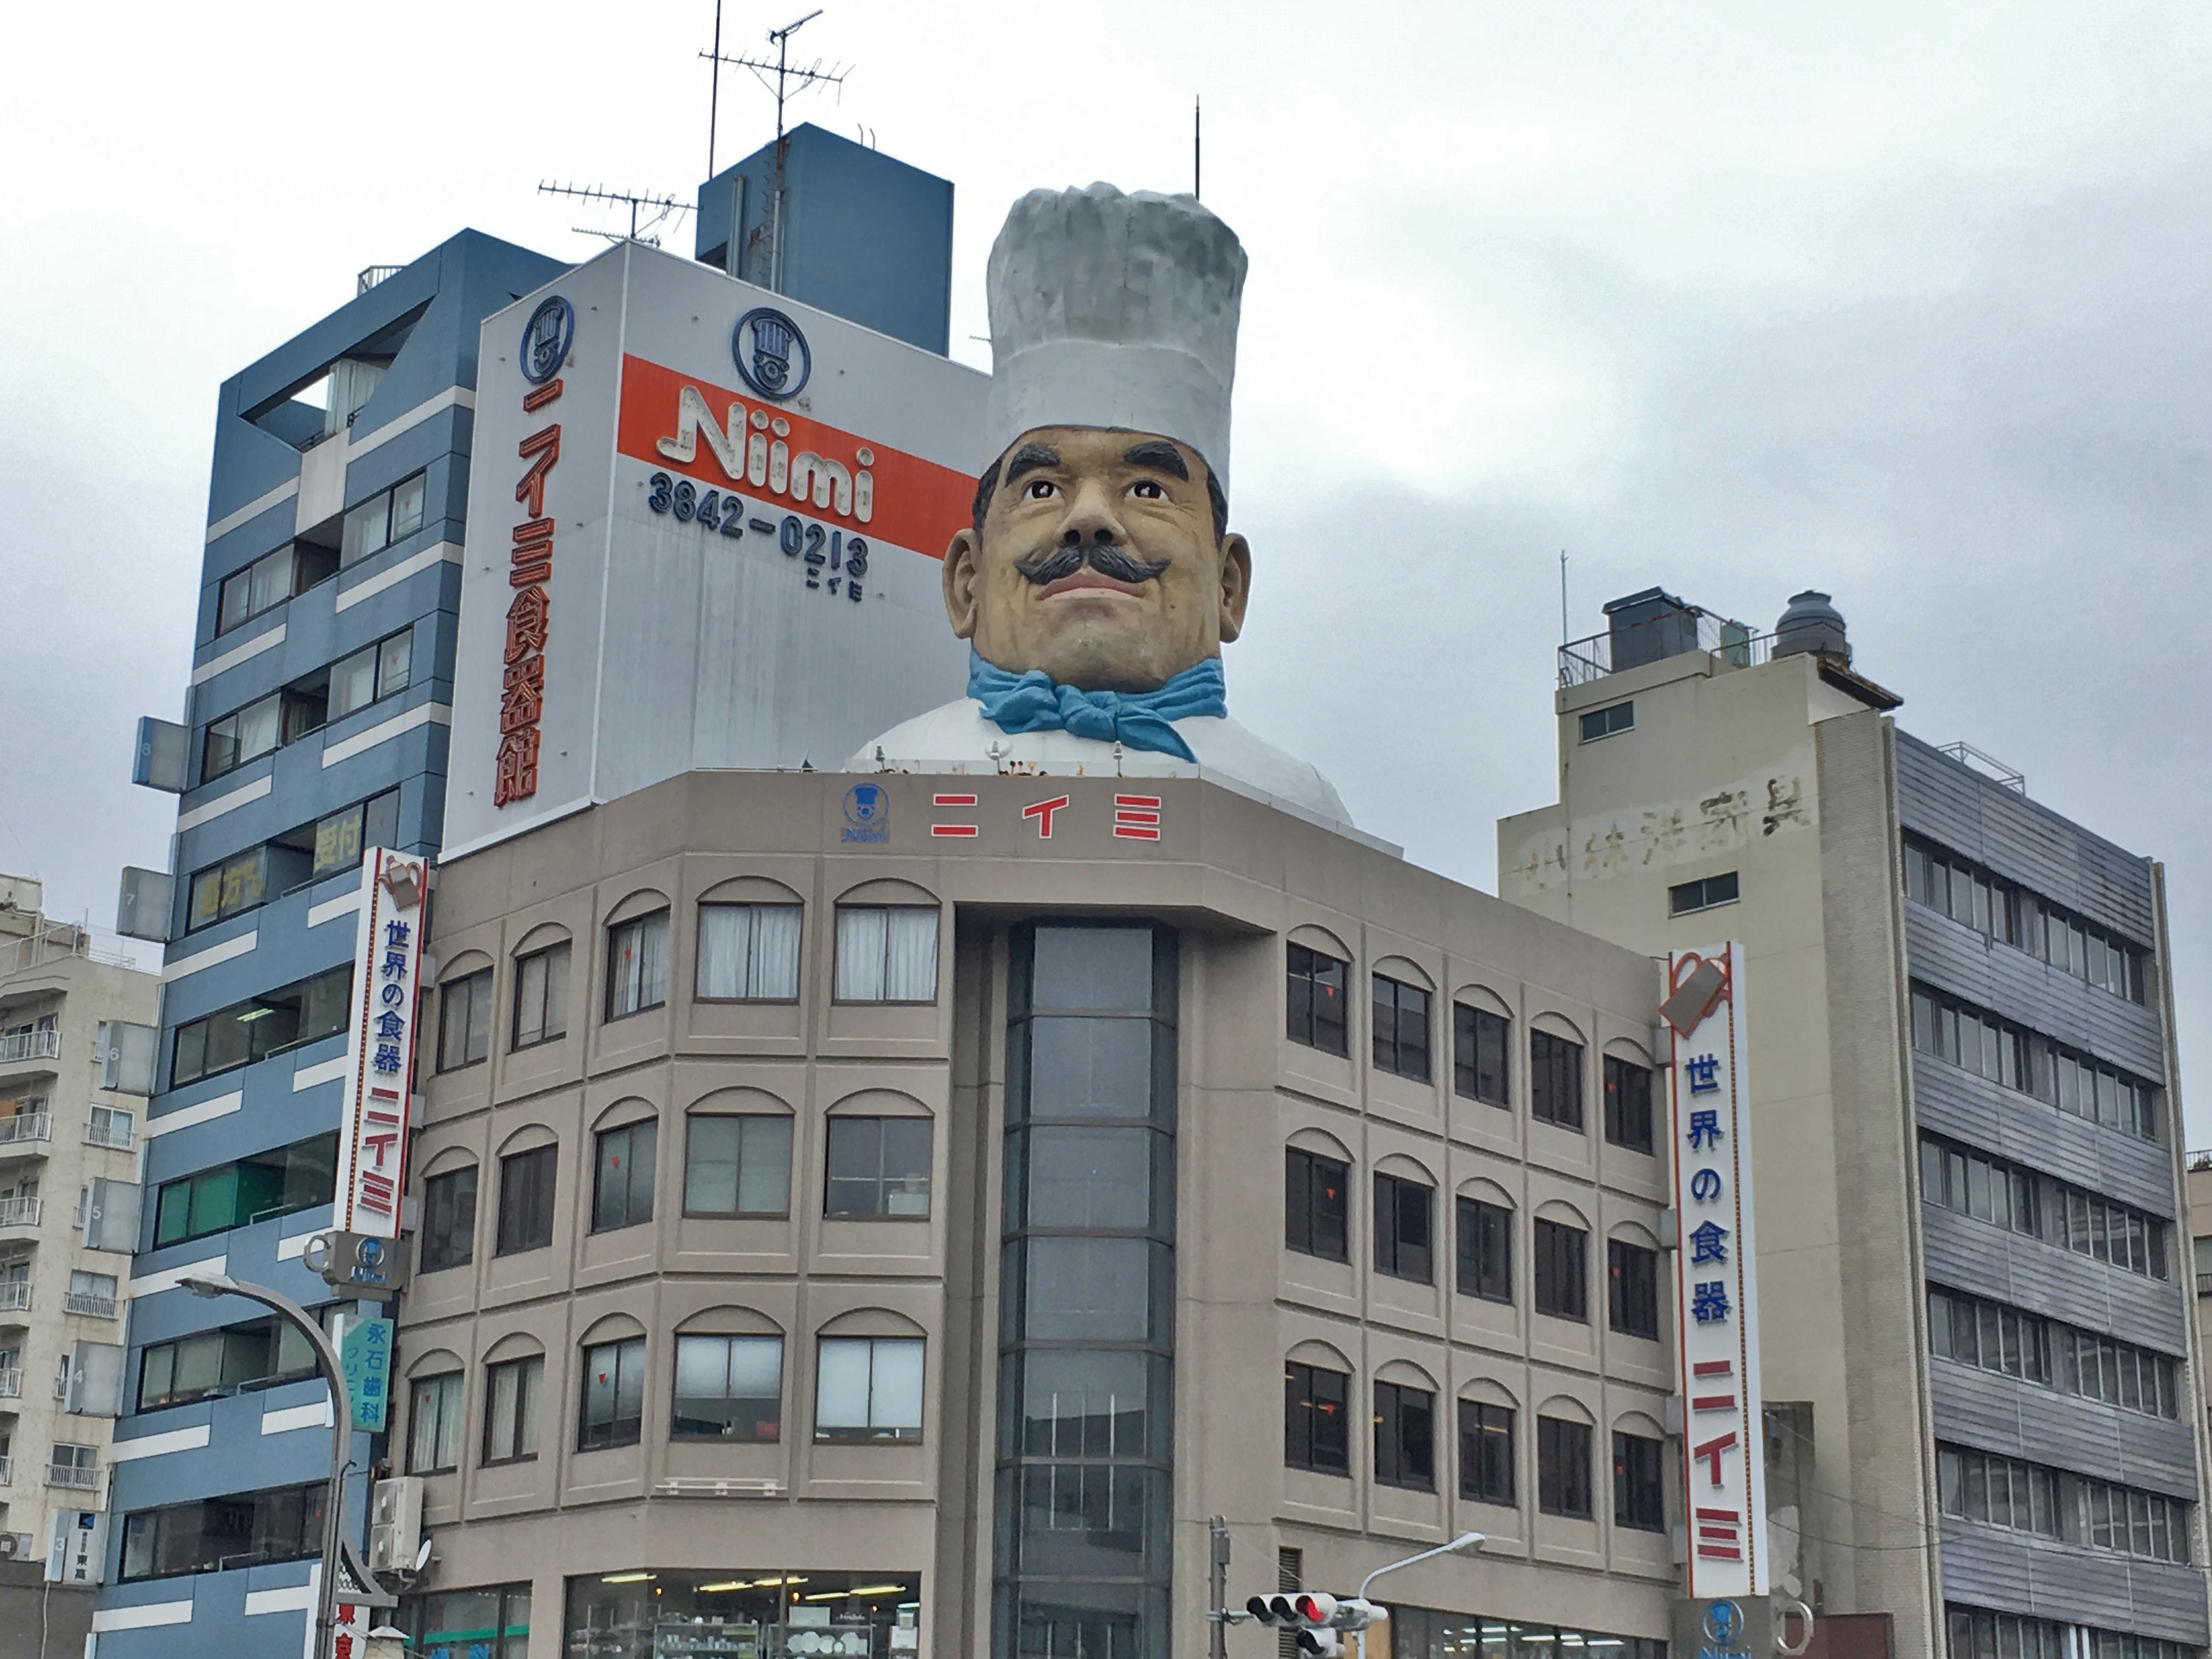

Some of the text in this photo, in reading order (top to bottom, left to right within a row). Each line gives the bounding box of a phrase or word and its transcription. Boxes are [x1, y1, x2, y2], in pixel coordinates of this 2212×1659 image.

[656, 385, 874, 524] Niimi
[648, 472, 868, 578] 3842-0213
[495, 379, 563, 807] ニイミ食器館
[142, 743, 150, 755] 8
[931, 794, 1161, 841] ニイミ
[127, 893, 136, 906] 7
[110, 1048, 119, 1060] 6
[358, 920, 411, 1215] 世界の食器 ニイミ
[92, 1206, 101, 1219] 5
[1685, 1053, 1741, 1561] 世界の食器 ニイミ
[74, 1369, 83, 1383] 4
[346, 1347, 359, 1414] クリニ
[360, 1323, 386, 1423] 永石歯科
[55, 1537, 65, 1551] 3
